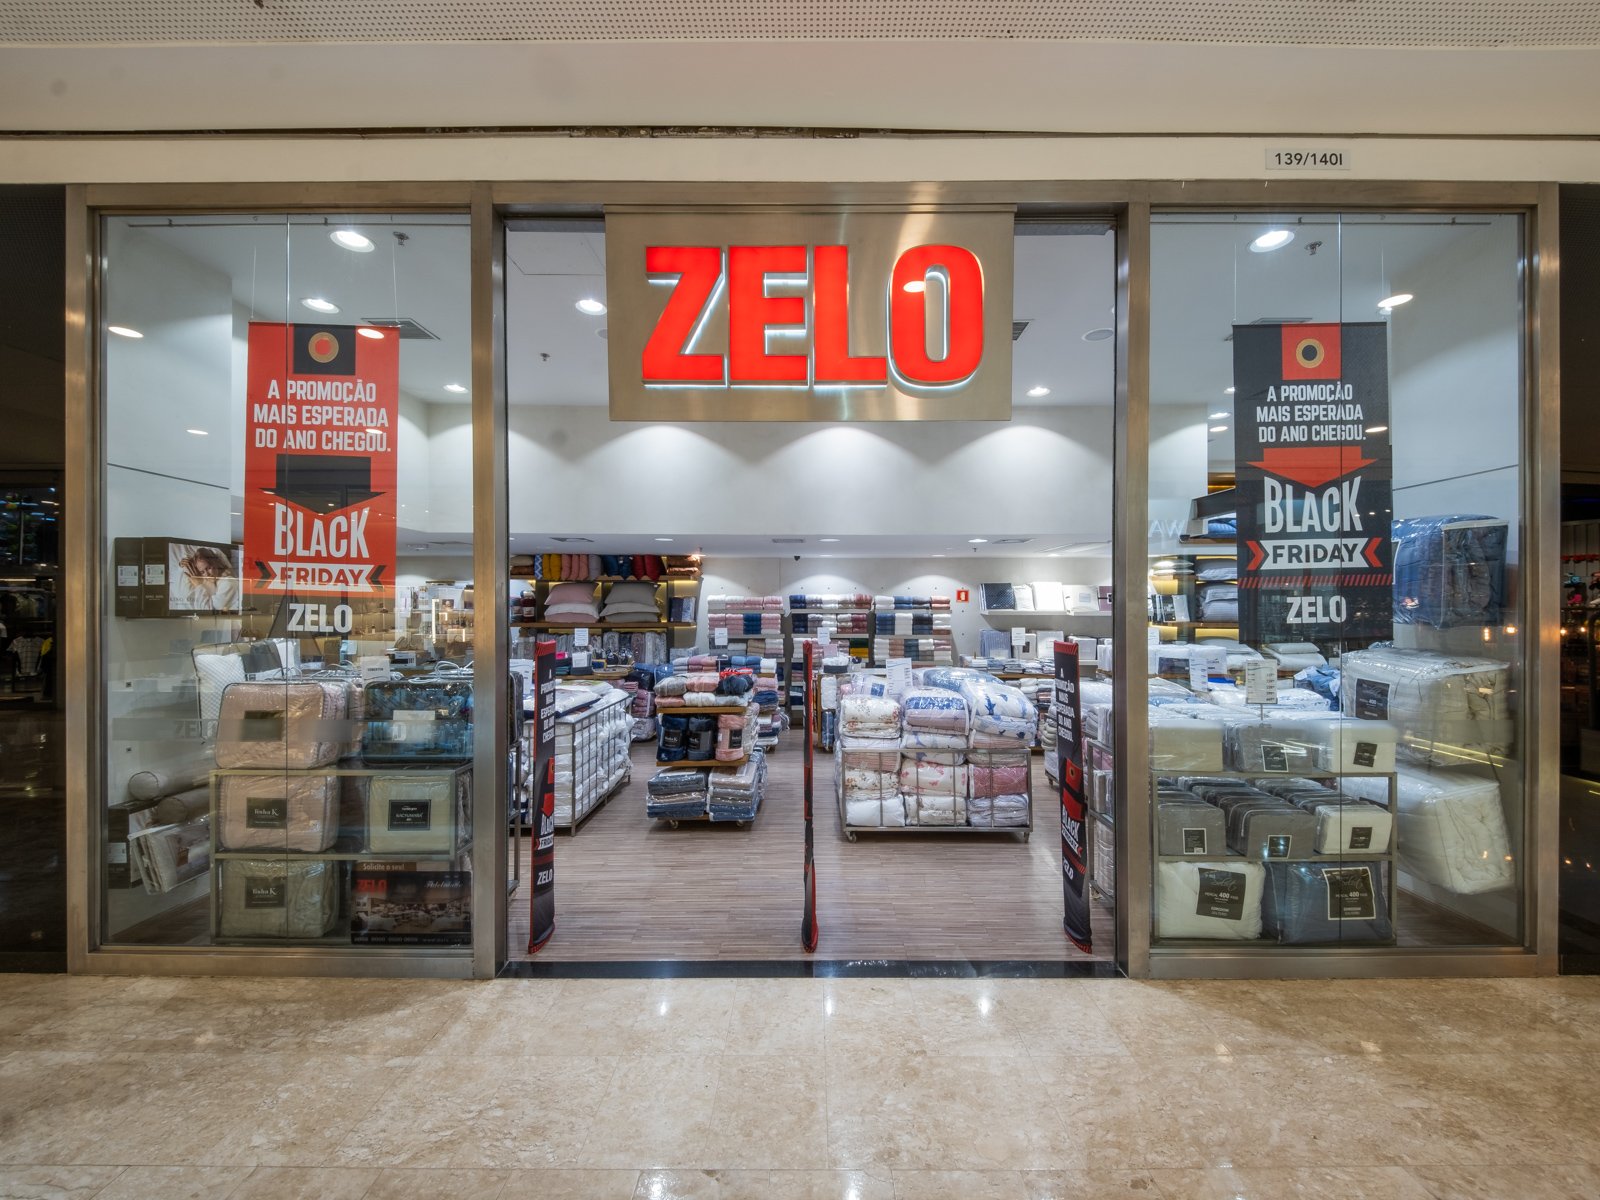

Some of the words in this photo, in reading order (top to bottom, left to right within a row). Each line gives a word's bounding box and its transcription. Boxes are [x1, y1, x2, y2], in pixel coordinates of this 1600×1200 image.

[642, 244, 985, 386] ZELO
[267, 379, 280, 399] A
[287, 379, 376, 404] PROMOÇÃO
[1266, 385, 1277, 402] A
[1281, 381, 1353, 404] PROMOÇÃO
[253, 403, 297, 425] MAIS
[302, 405, 388, 428] ESPERADA
[1256, 405, 1291, 423] MAIS
[1294, 404, 1363, 422] ESPERADA
[255, 428, 277, 448] DO
[283, 429, 317, 450] ANO
[321, 430, 391, 453] CHEGOU.
[1258, 426, 1276, 443] DO
[1280, 425, 1308, 443] ANO
[1312, 424, 1367, 442] CHEGOU.
[1263, 475, 1363, 534] BLACK
[274, 501, 370, 559] BLACK
[1272, 543, 1359, 564] FRIDAY
[280, 566, 364, 586] FRIDAY
[287, 602, 353, 633] ZELO
[1286, 594, 1347, 625] ZELO
[1062, 803, 1080, 842] BLACK
[537, 868, 553, 886] ZELO
